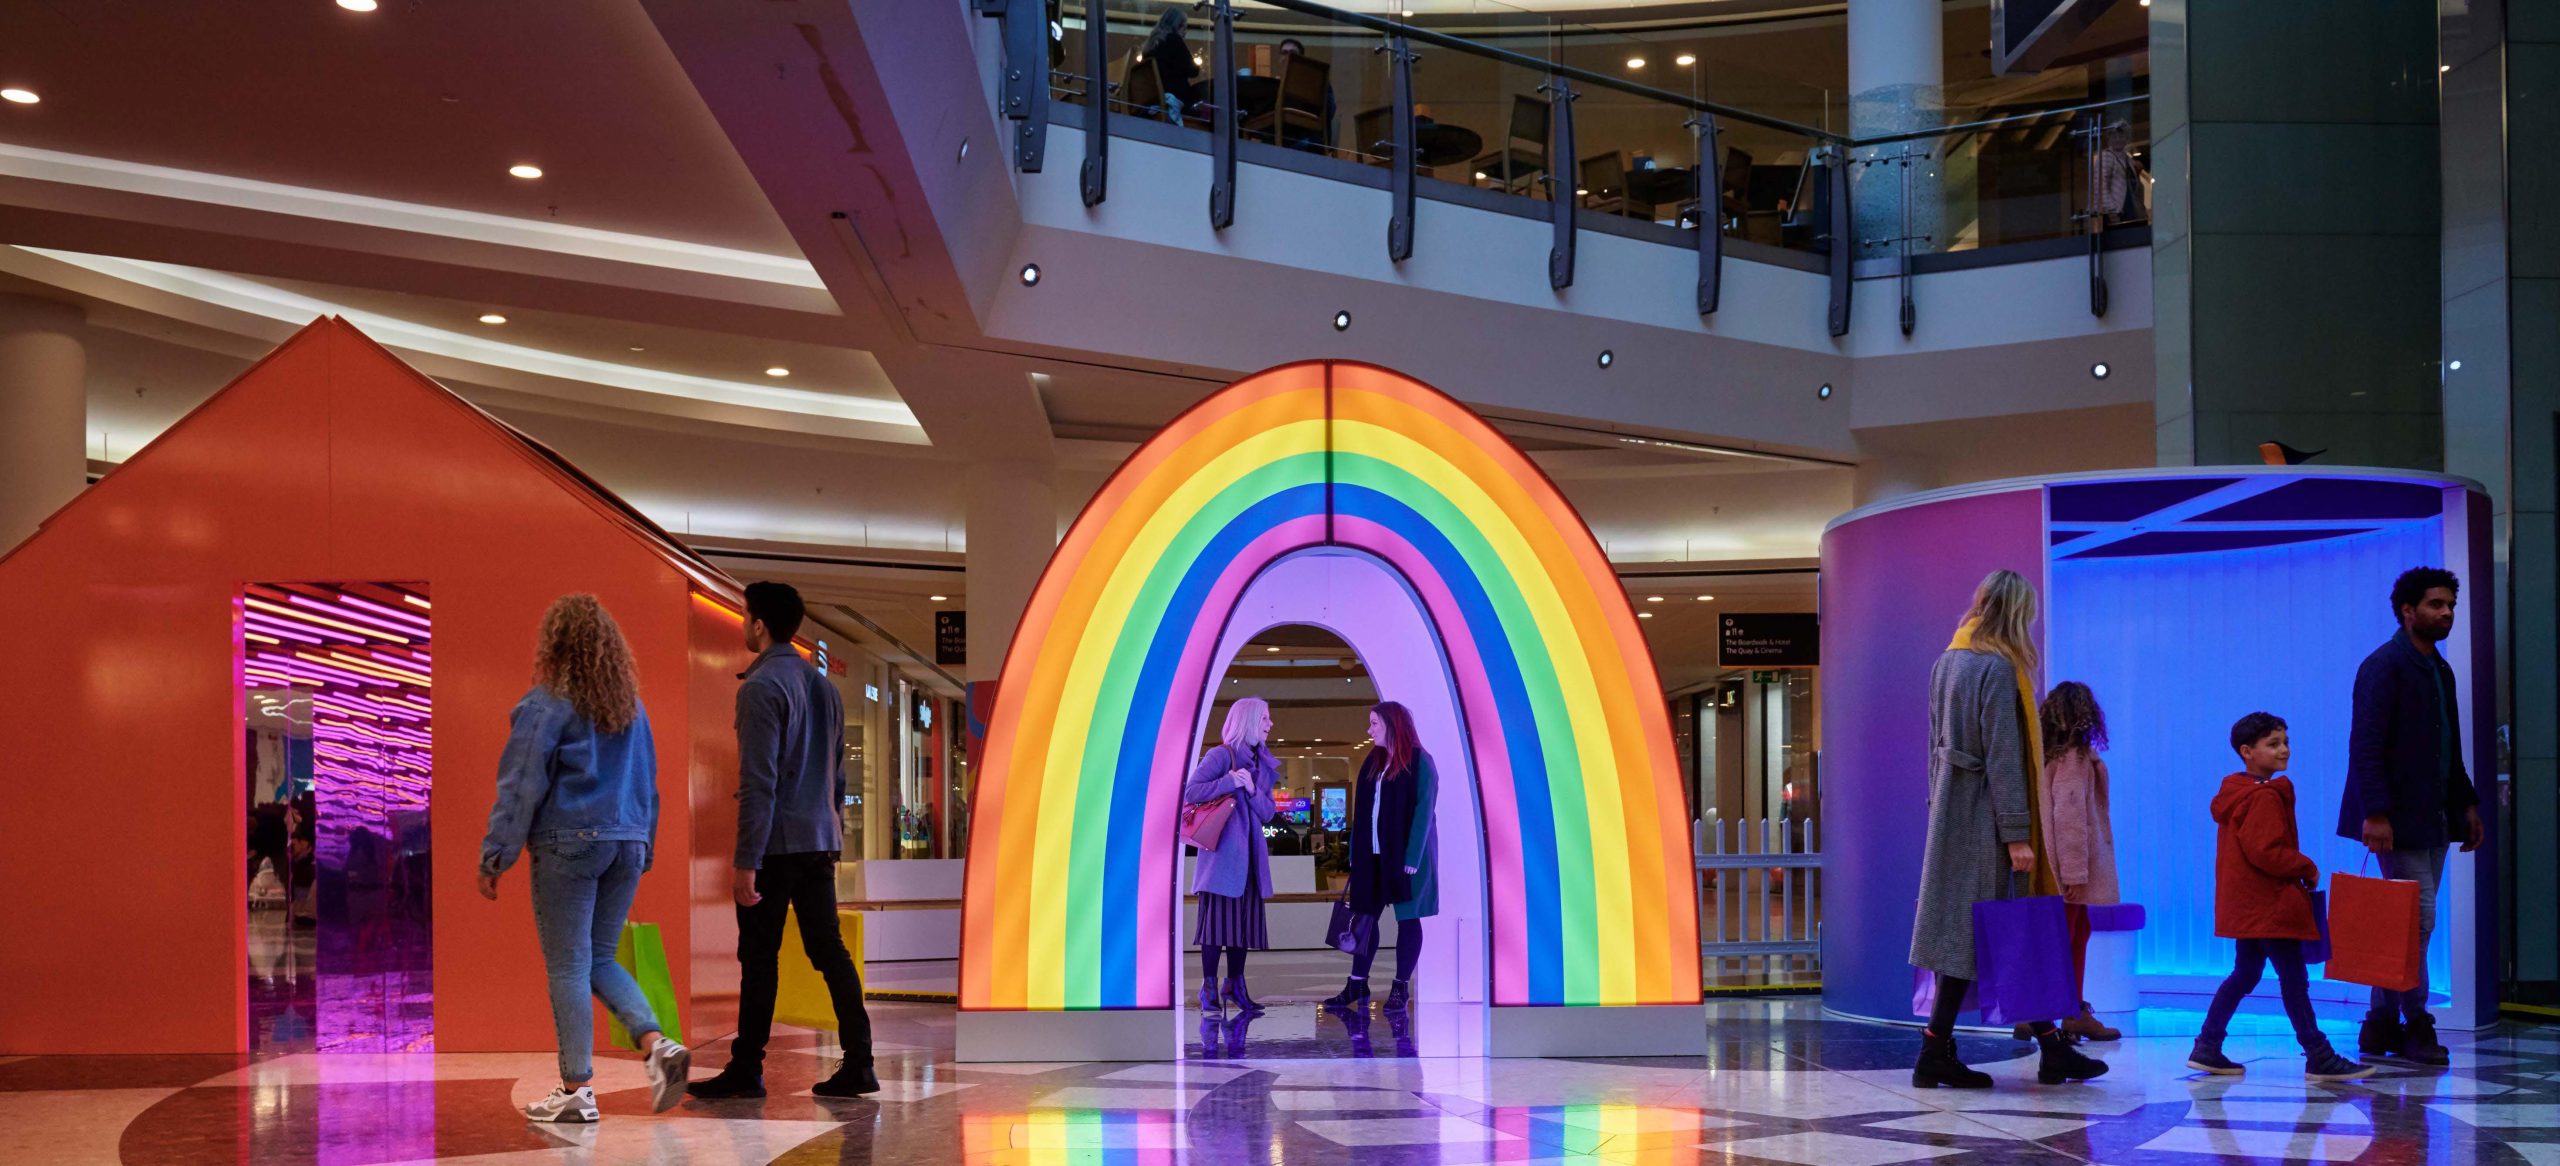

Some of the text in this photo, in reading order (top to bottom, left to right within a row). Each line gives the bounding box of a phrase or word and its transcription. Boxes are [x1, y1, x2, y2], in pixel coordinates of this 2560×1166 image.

[1726, 647, 1737, 655] The
[1738, 647, 1753, 655] Quay
[1760, 647, 1783, 655] Cinema
